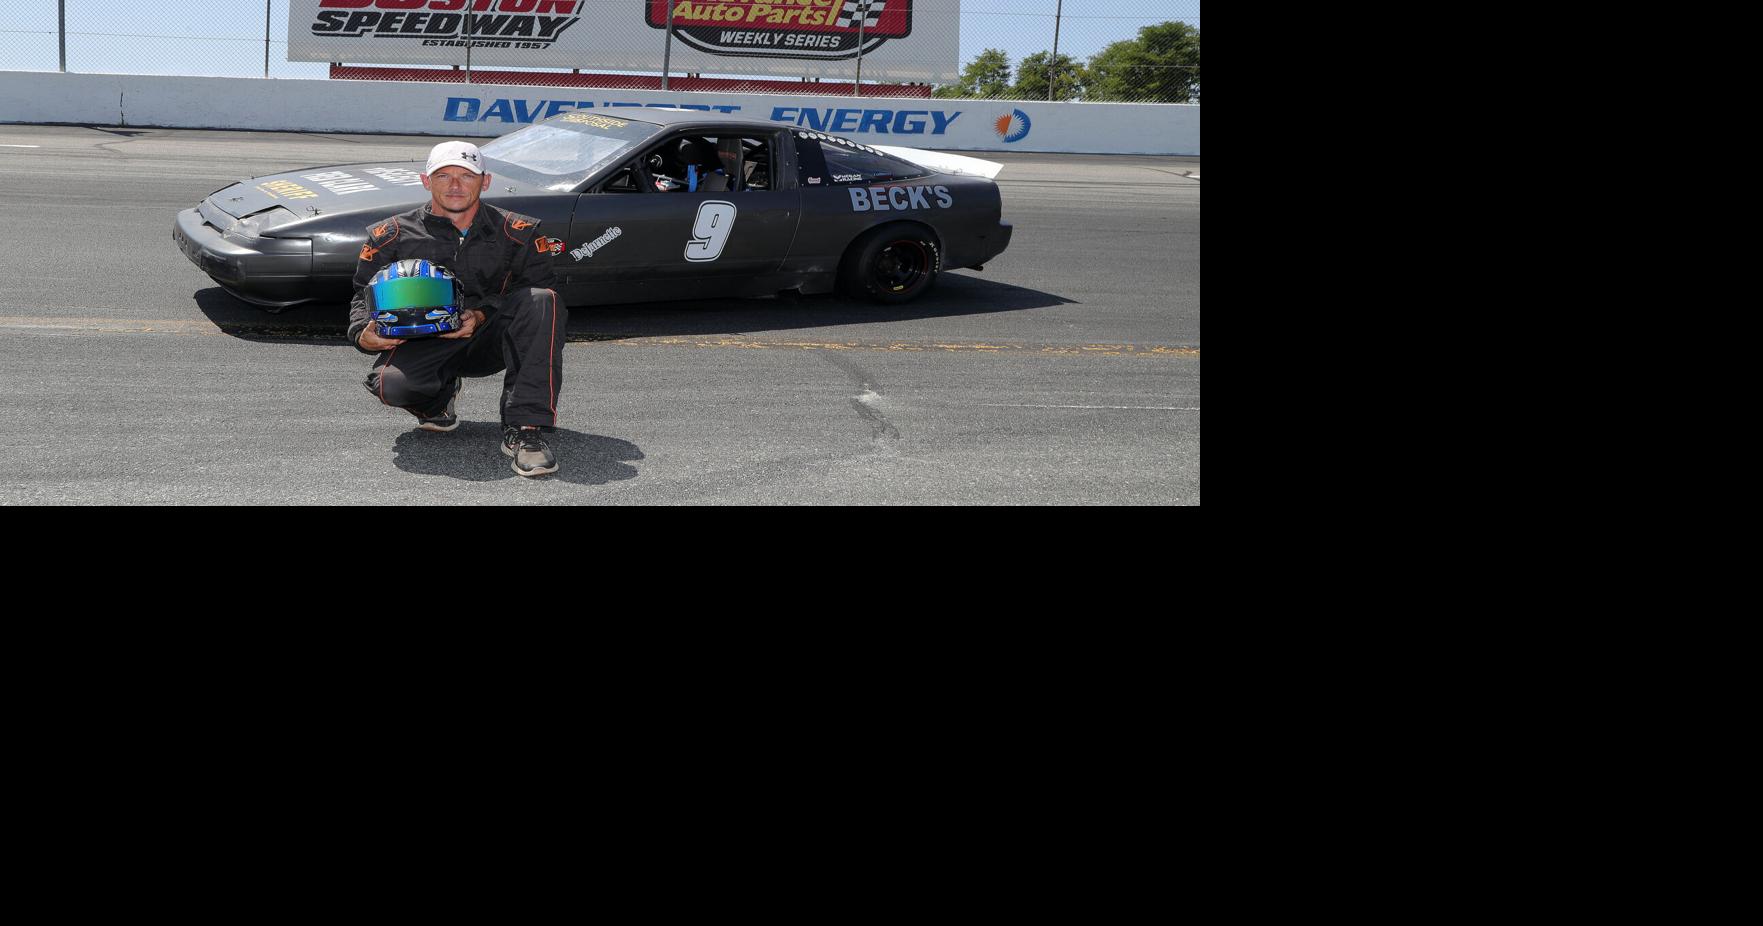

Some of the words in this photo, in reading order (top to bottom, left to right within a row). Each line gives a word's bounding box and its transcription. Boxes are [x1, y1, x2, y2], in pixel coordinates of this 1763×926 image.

[311, 10, 572, 37] SPEEDWAY
[672, 1, 744, 22] Auto
[745, 3, 827, 25] Parts
[421, 39, 511, 49] ESTABLISHED
[514, 41, 551, 50] 1957
[719, 30, 783, 45] WEEKLY
[786, 33, 842, 48] SERIES
[769, 106, 963, 134] ENERGY
[847, 184, 953, 212] BECK'S
[684, 200, 737, 262] 9
